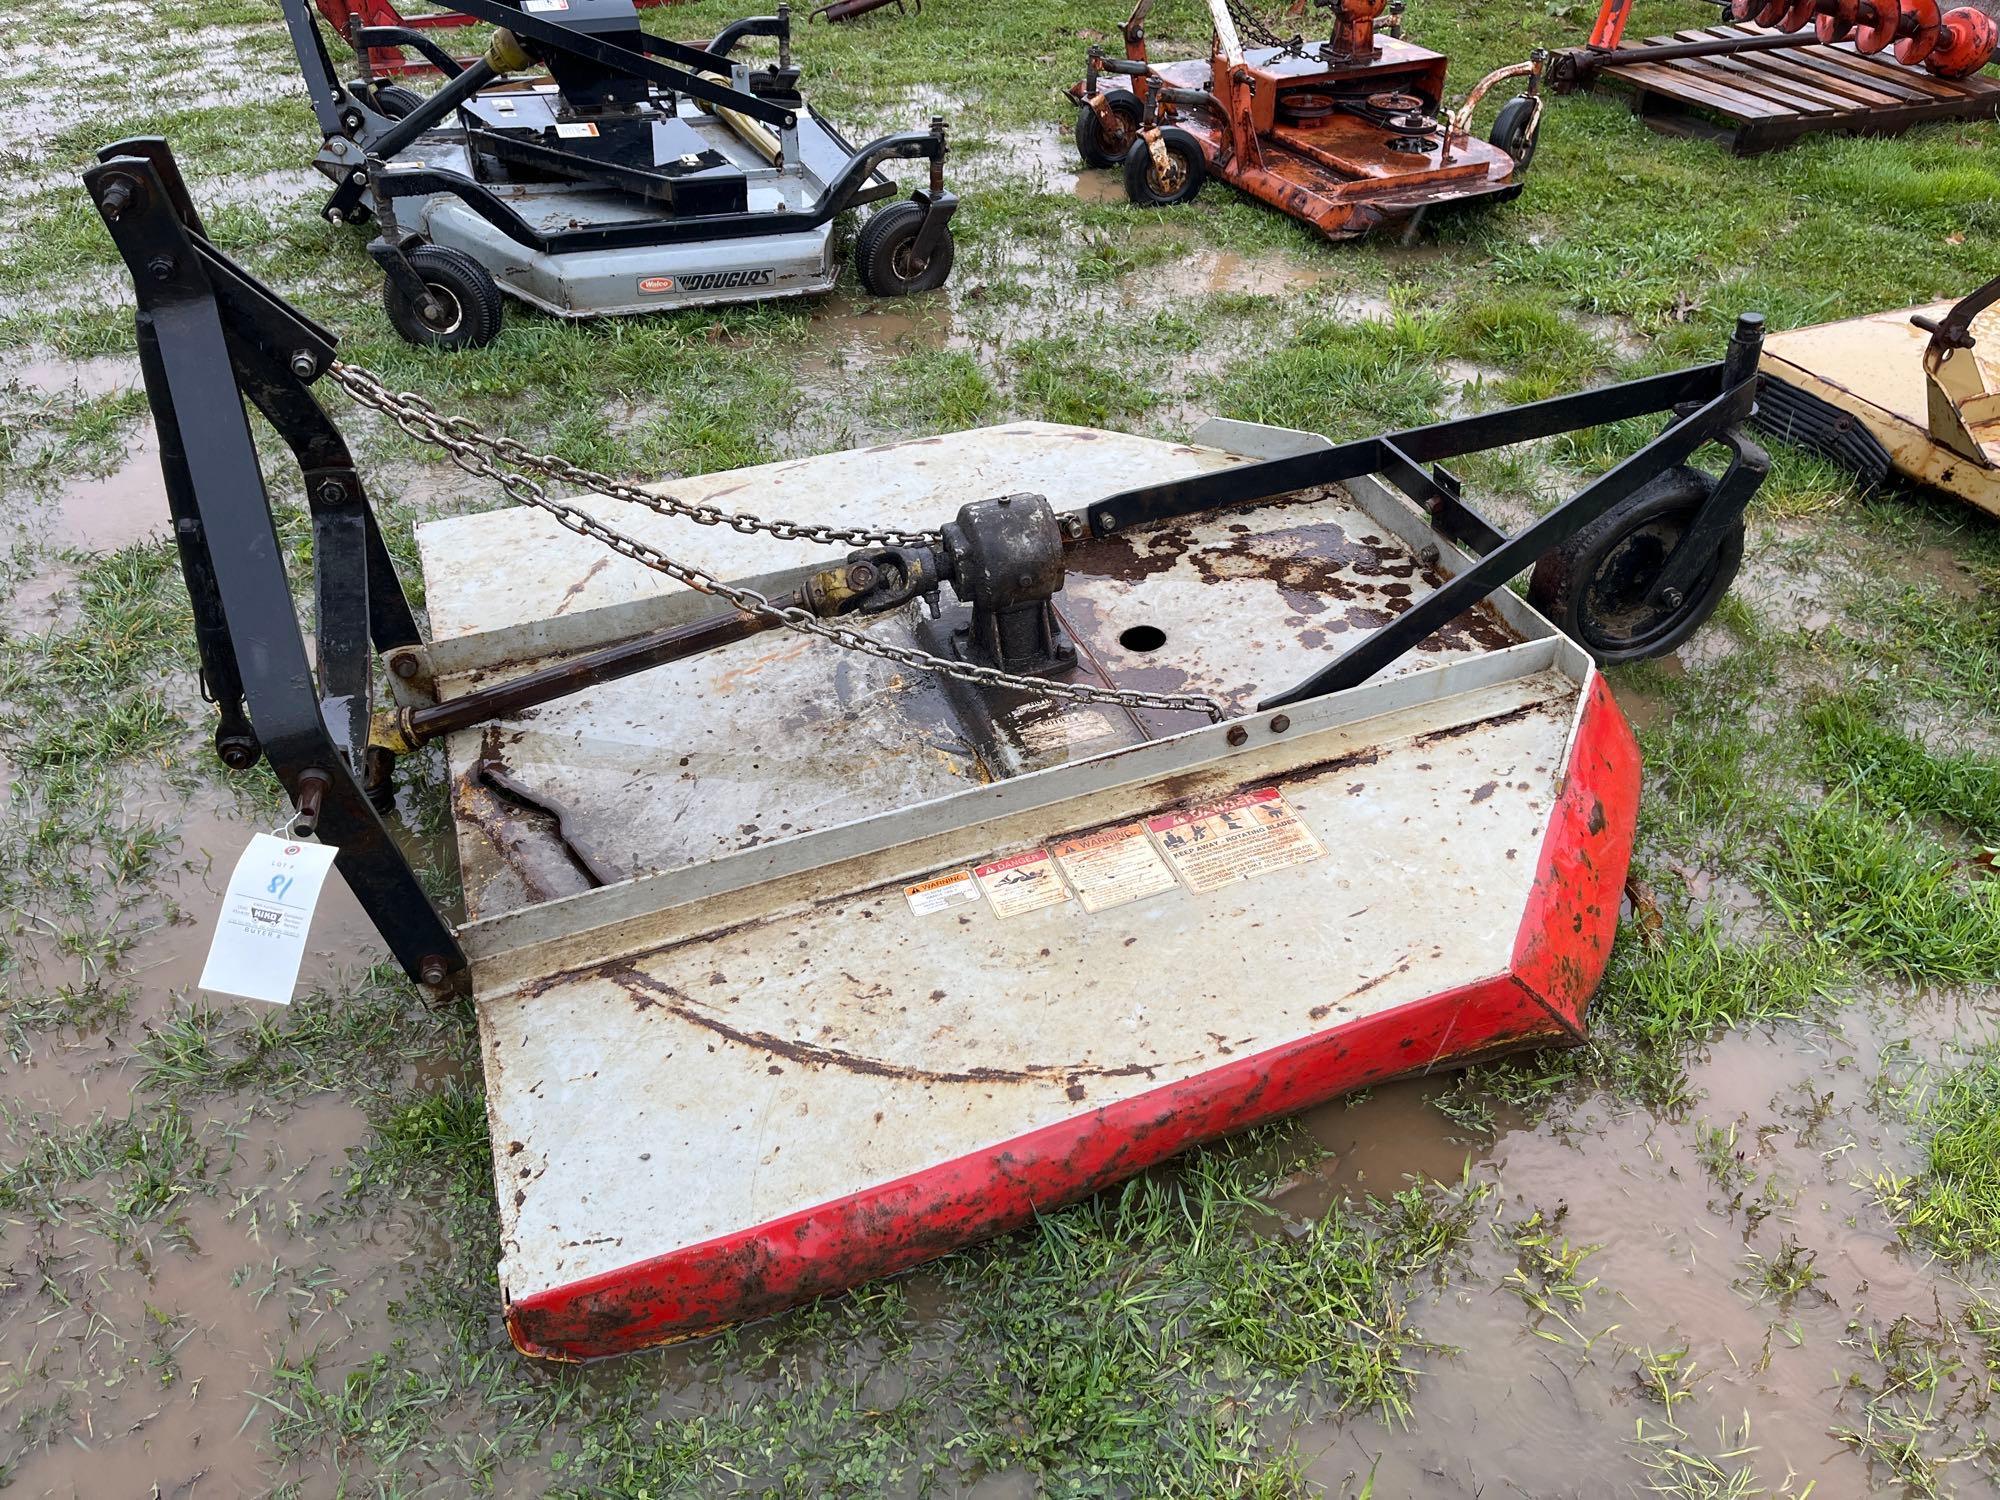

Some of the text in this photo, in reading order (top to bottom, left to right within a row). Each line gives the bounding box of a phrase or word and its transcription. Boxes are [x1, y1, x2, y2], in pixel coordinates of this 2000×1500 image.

[644, 279, 670, 289] Walco
[1078, 829, 1134, 849] WARNING
[1171, 847, 1196, 859] KEEP
[1194, 840, 1221, 852] AWAY
[1224, 827, 1267, 844] ROTATING
[1265, 818, 1299, 832] BLADES
[996, 853, 1040, 871] DANGER
[267, 874, 294, 900] 81
[921, 874, 964, 891] WARNING
[254, 909, 278, 920] KIKO
[244, 926, 273, 937] BUYER
